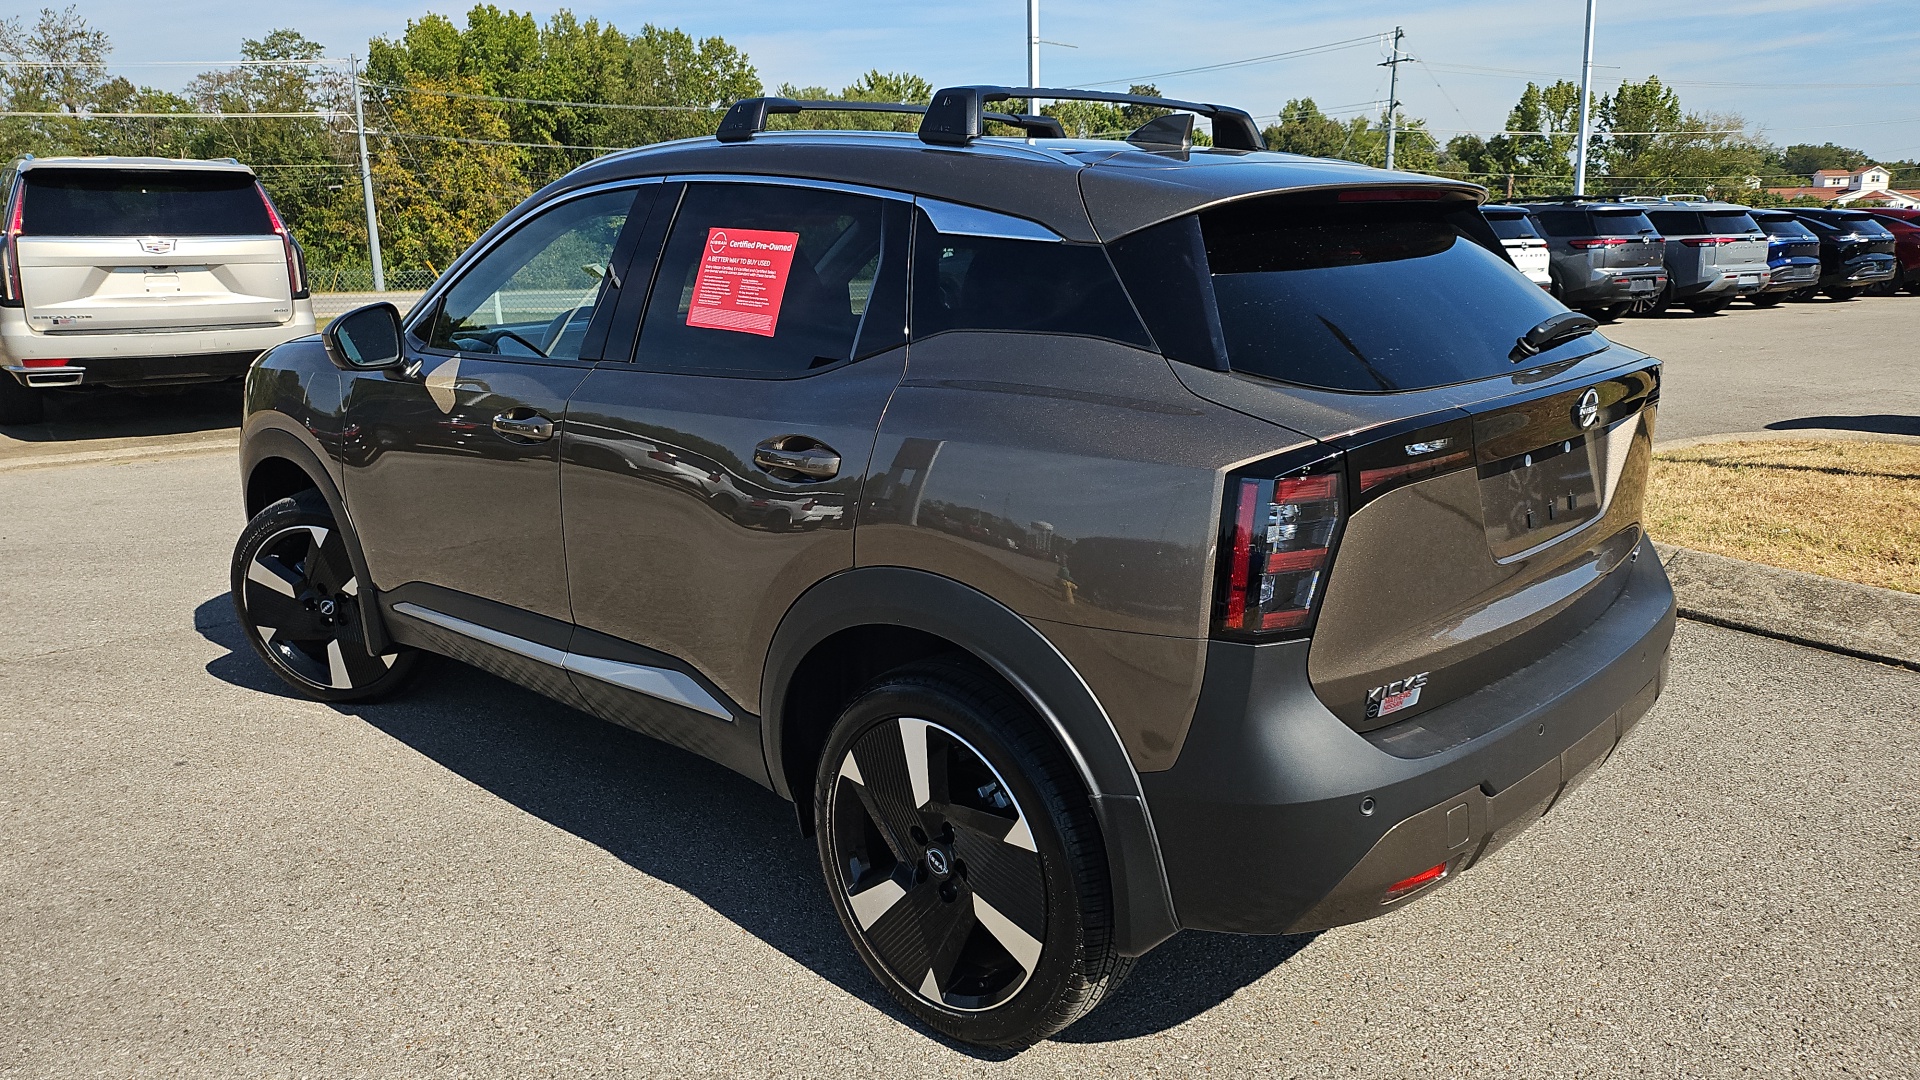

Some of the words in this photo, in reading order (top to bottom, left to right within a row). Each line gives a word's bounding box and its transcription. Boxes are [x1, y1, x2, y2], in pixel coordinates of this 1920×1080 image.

[729, 240, 756, 249] Certified
[756, 241, 793, 252] Pre-Owned
[747, 258, 758, 266] BUY
[1367, 671, 1430, 705] KICKS
